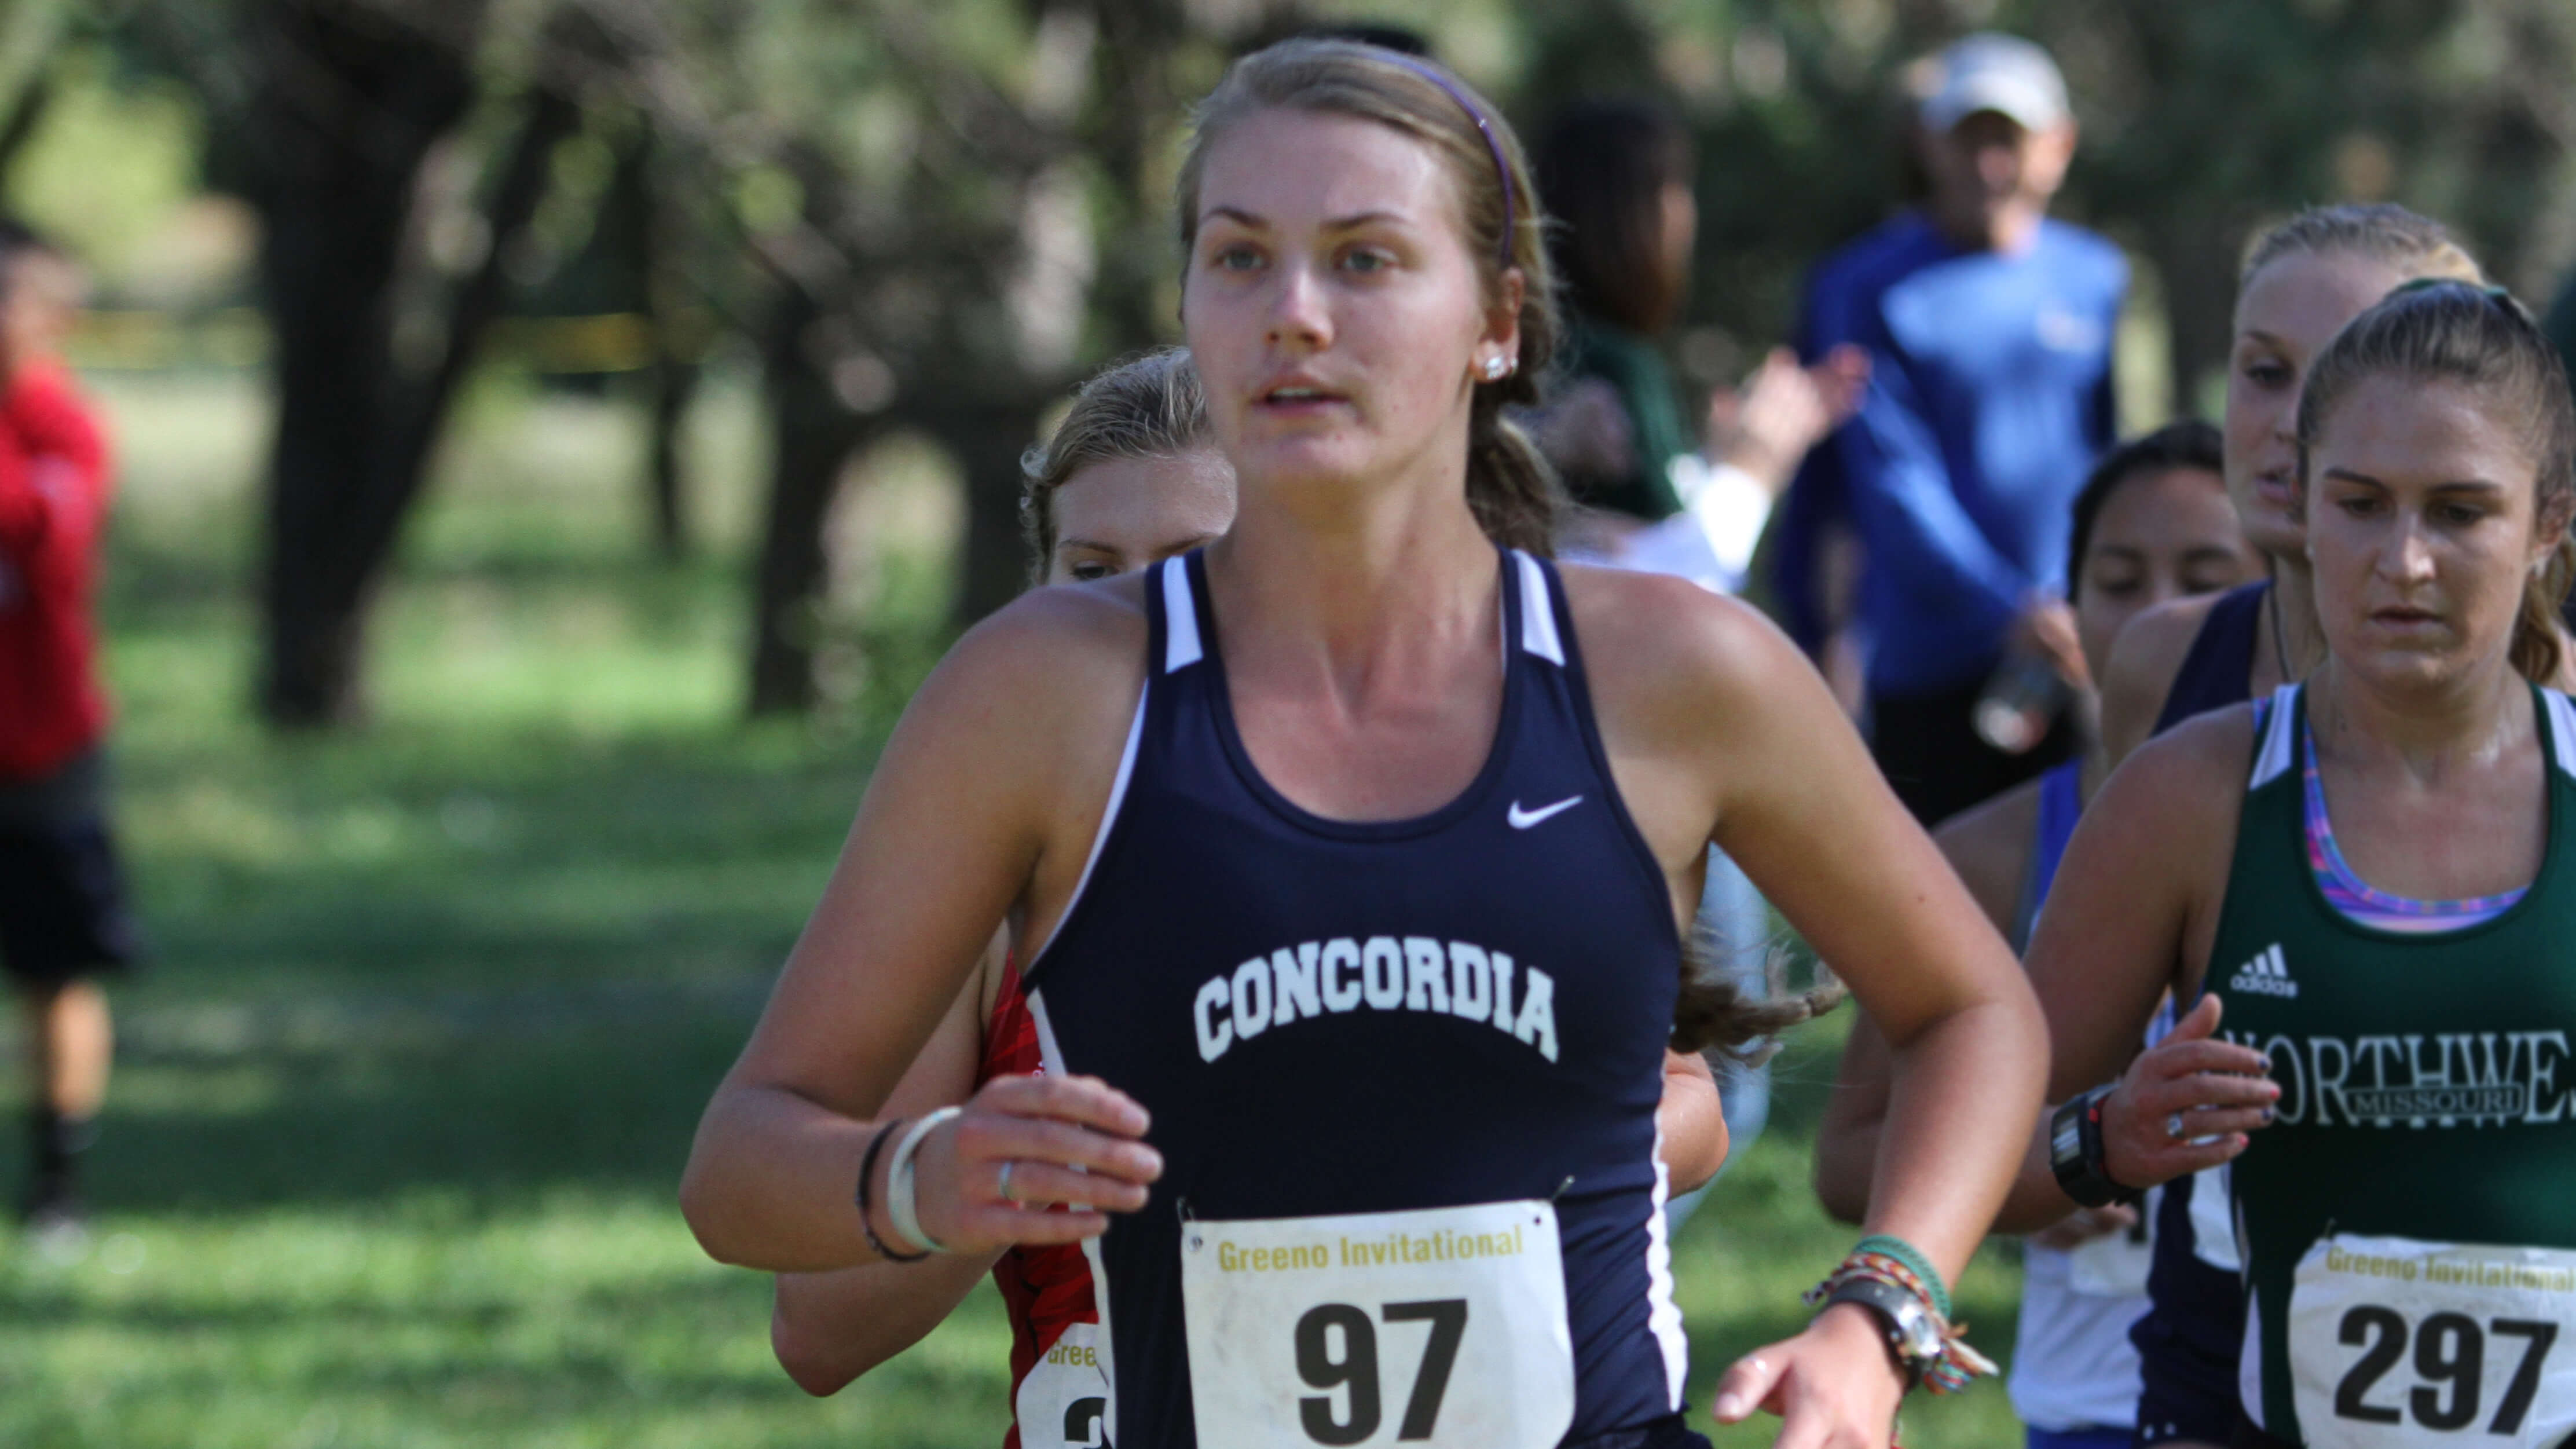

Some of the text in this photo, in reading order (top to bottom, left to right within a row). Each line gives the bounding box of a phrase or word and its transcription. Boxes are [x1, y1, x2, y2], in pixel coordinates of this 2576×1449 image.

[1194, 936, 1558, 1063] CONCORDIA
[2230, 974, 2297, 998] adidas
[2225, 1030, 2576, 1127] ORTHWE
[2355, 1088, 2515, 1113] MISSOURI
[1219, 1225, 1524, 1273] Greeno Invitational
[2326, 1247, 2574, 1293] Greeno Invitational
[1048, 1339, 1097, 1367] Gree
[1295, 1298, 1468, 1446] 97
[2335, 1304, 2559, 1436] 297
